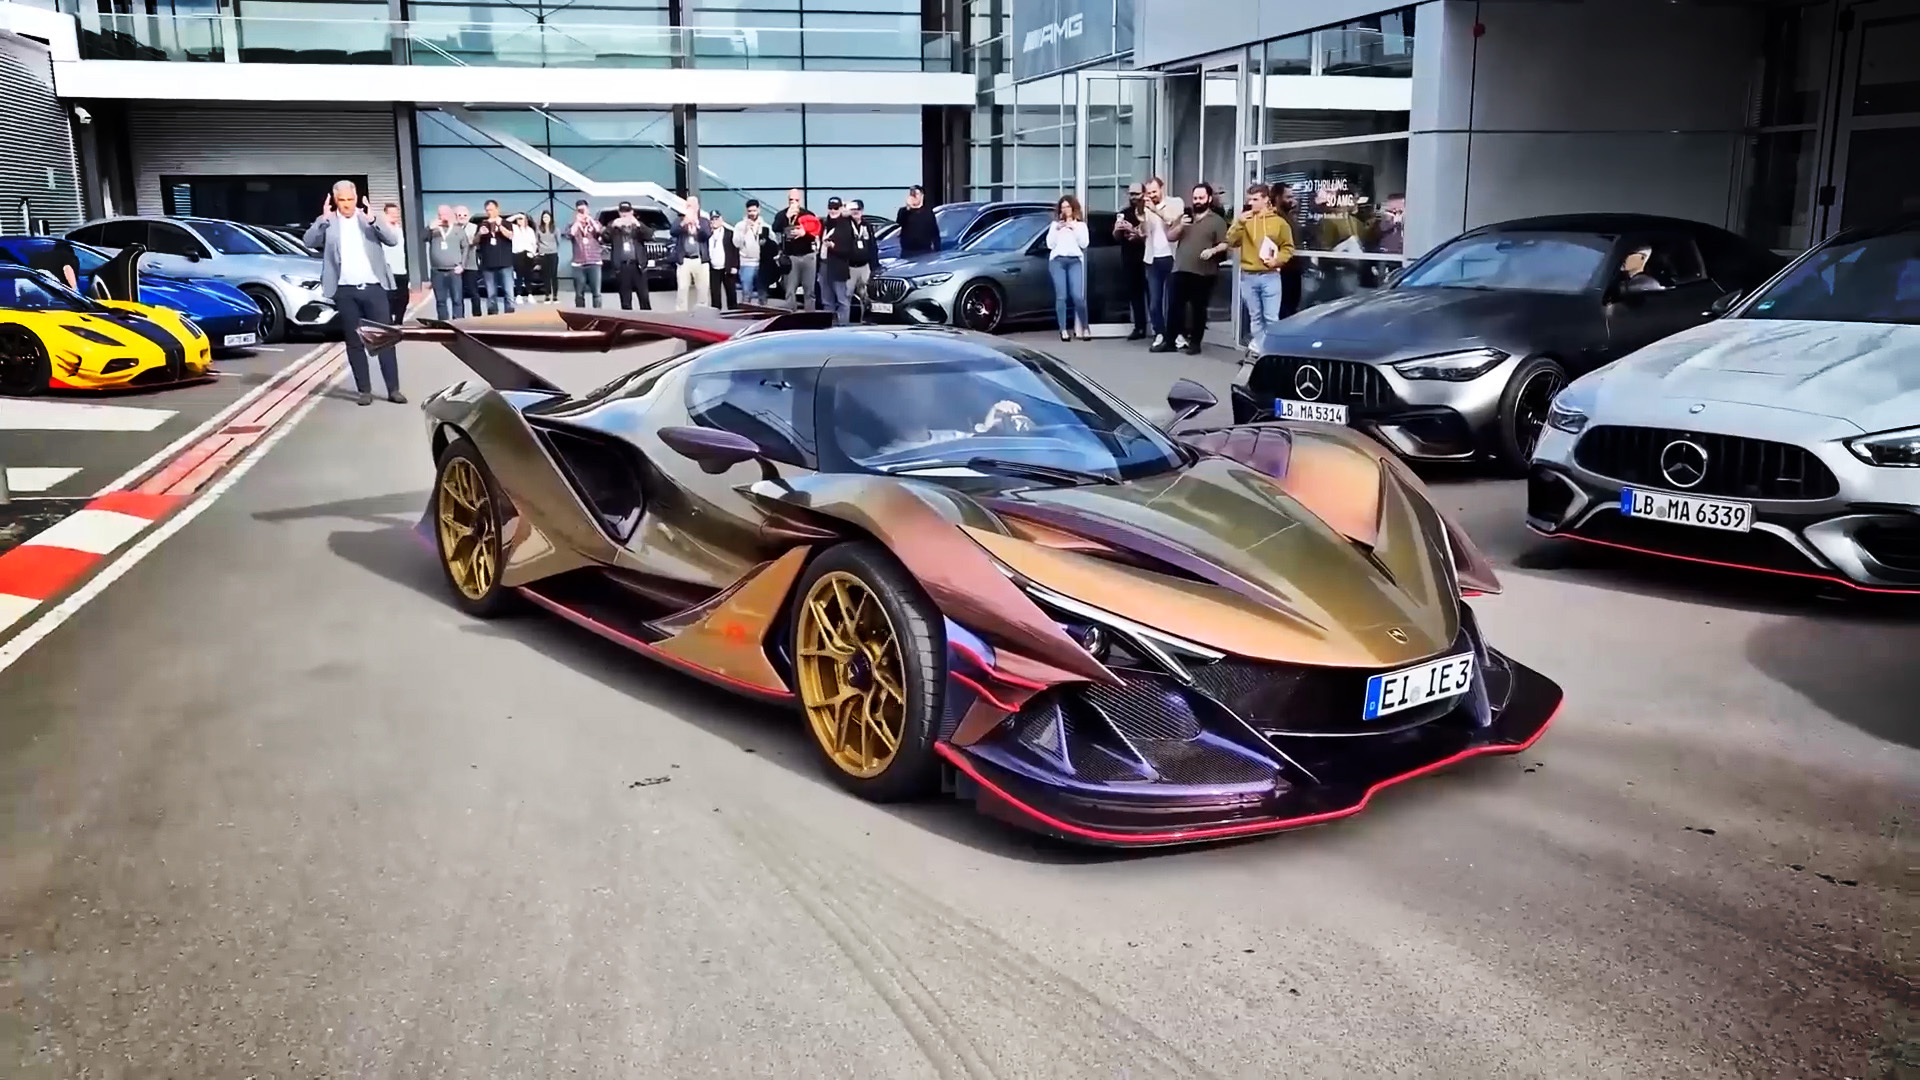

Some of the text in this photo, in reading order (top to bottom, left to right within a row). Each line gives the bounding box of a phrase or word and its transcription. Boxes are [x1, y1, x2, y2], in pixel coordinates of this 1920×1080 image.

[1040, 12, 1083, 48] AMG
[1305, 180, 1313, 192] SO
[1326, 194, 1336, 207] SO
[1281, 403, 1293, 417] LB
[1633, 493, 1746, 528] LB MA 6339
[1381, 675, 1409, 711] EI
